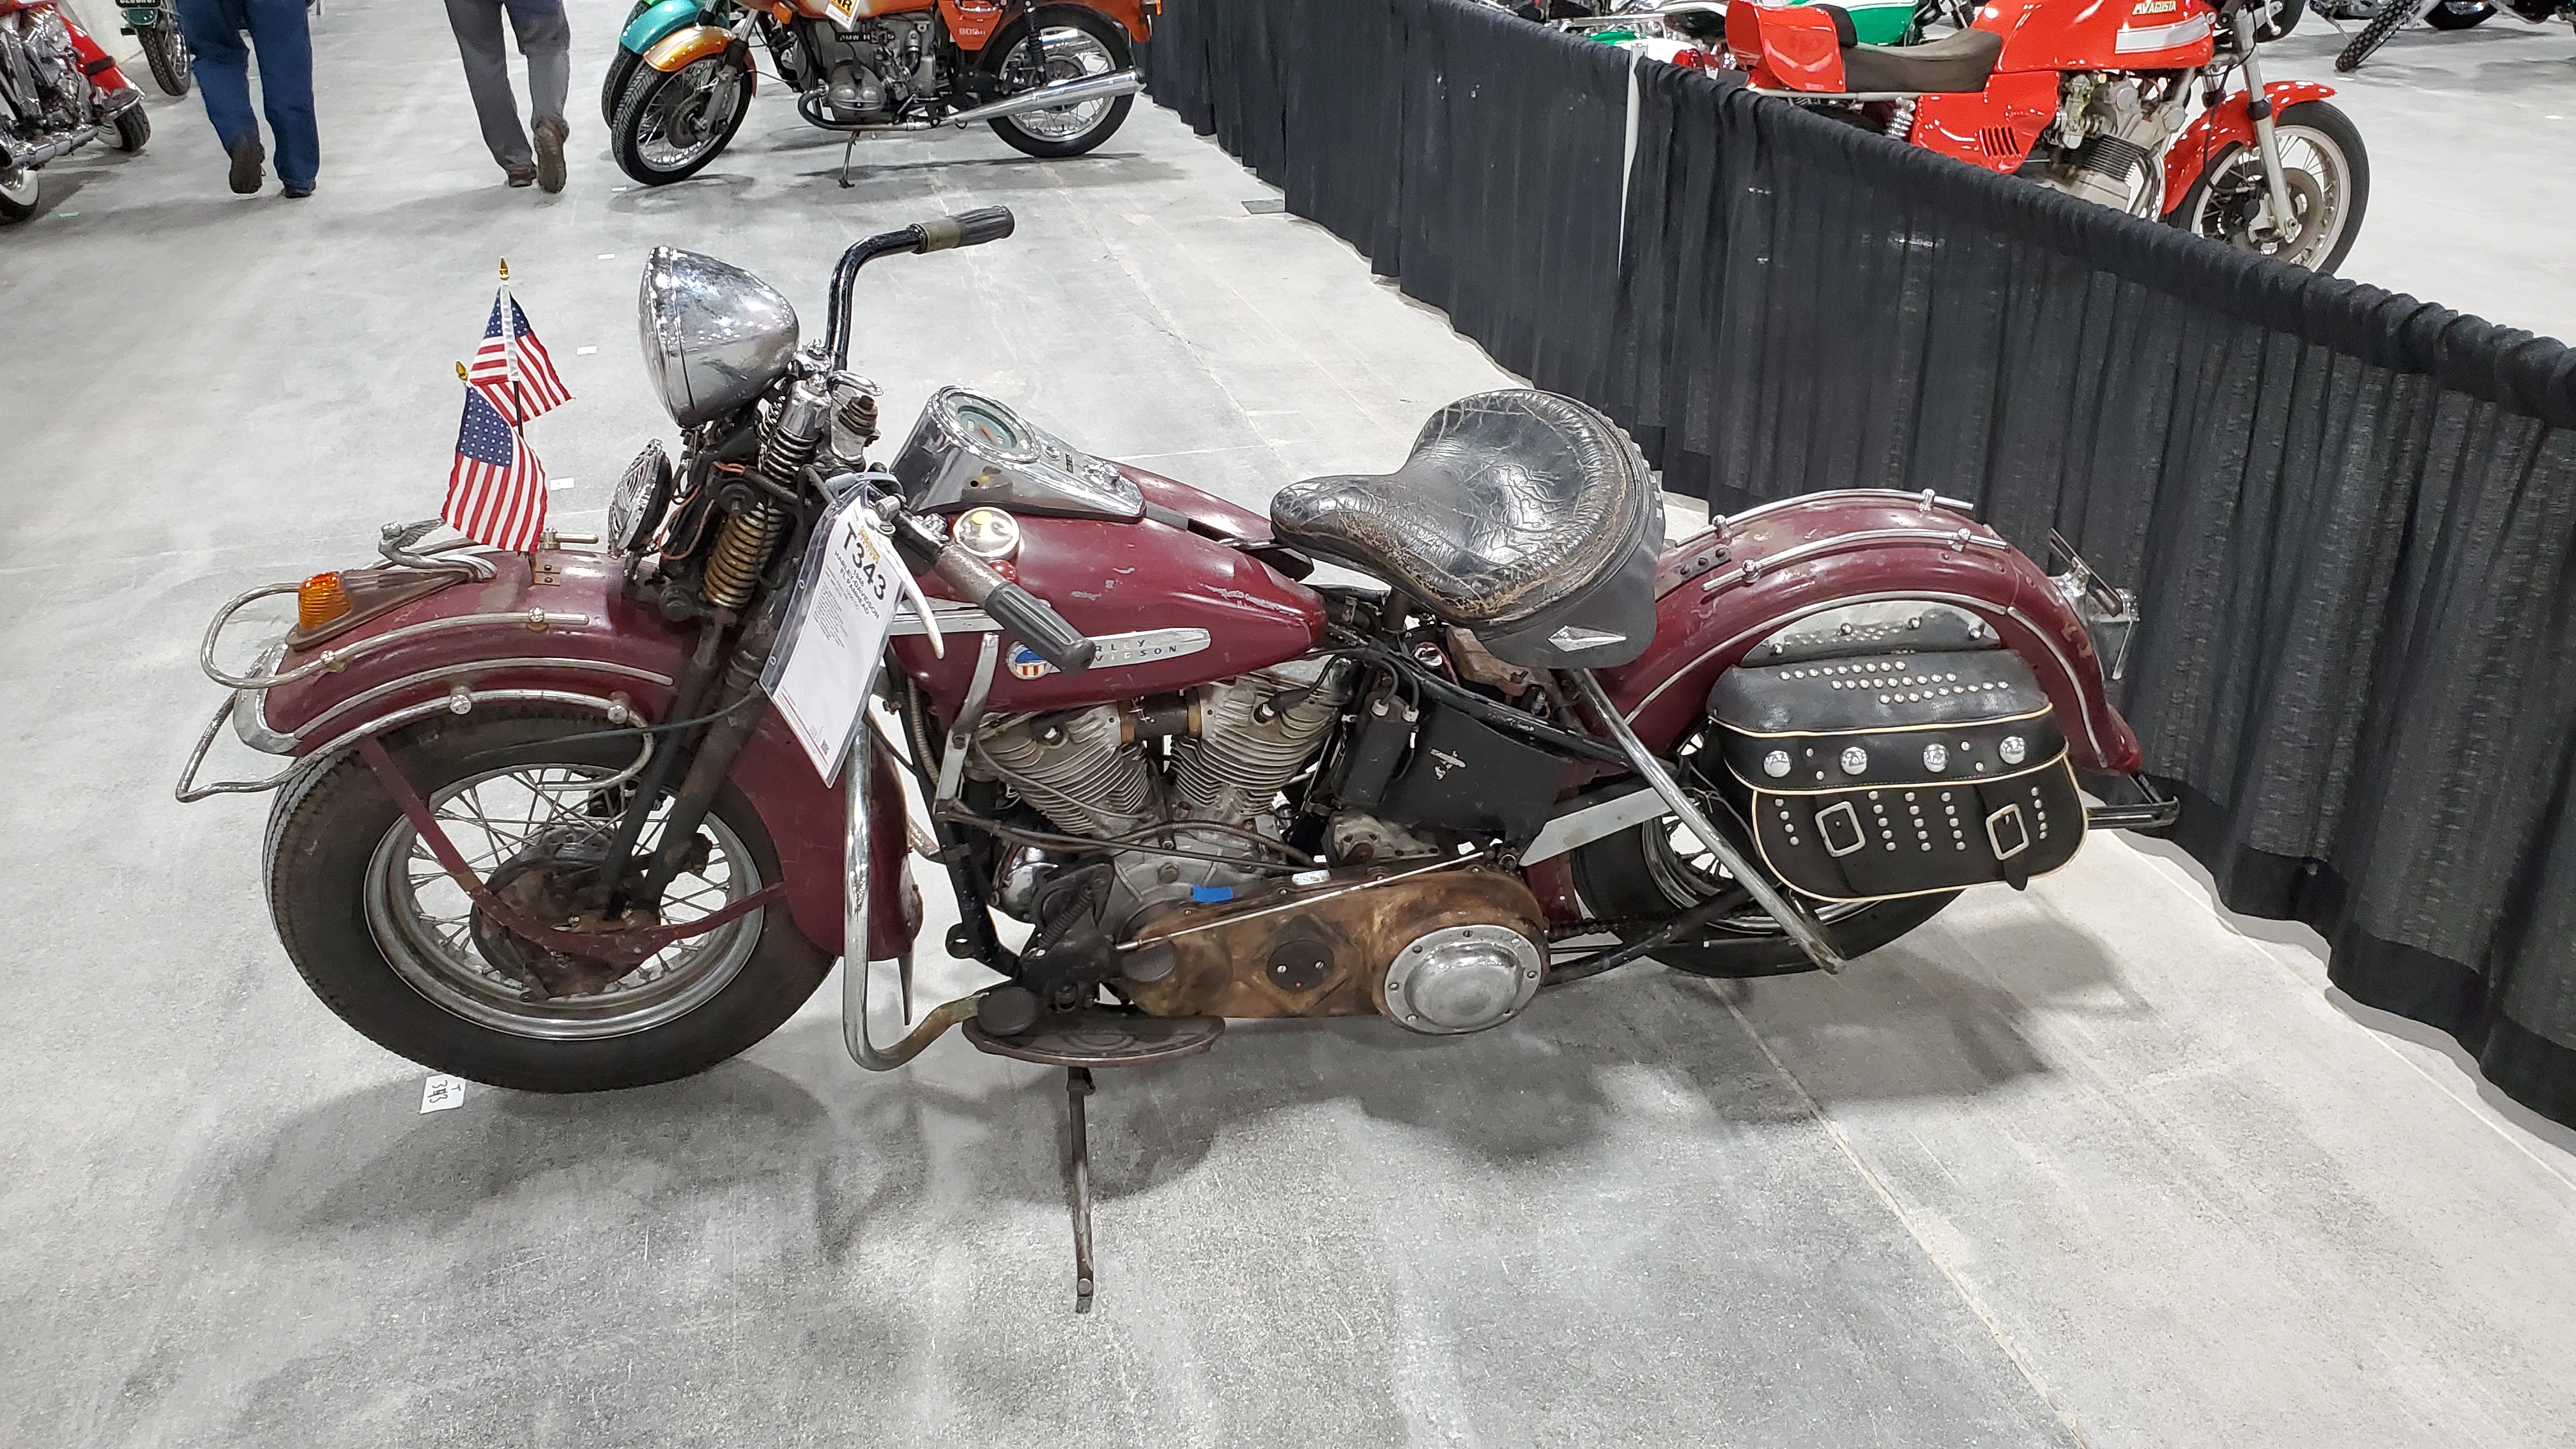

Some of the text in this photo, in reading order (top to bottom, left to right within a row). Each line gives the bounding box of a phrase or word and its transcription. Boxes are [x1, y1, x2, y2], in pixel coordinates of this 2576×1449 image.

[2149, 1, 2177, 13] AGUSTA
[844, 521, 886, 601] T343
[834, 550, 880, 619] HARLEY-DAVIDSON
[1095, 640, 1145, 652] RLEY
[1095, 645, 1177, 662] VIDSON
